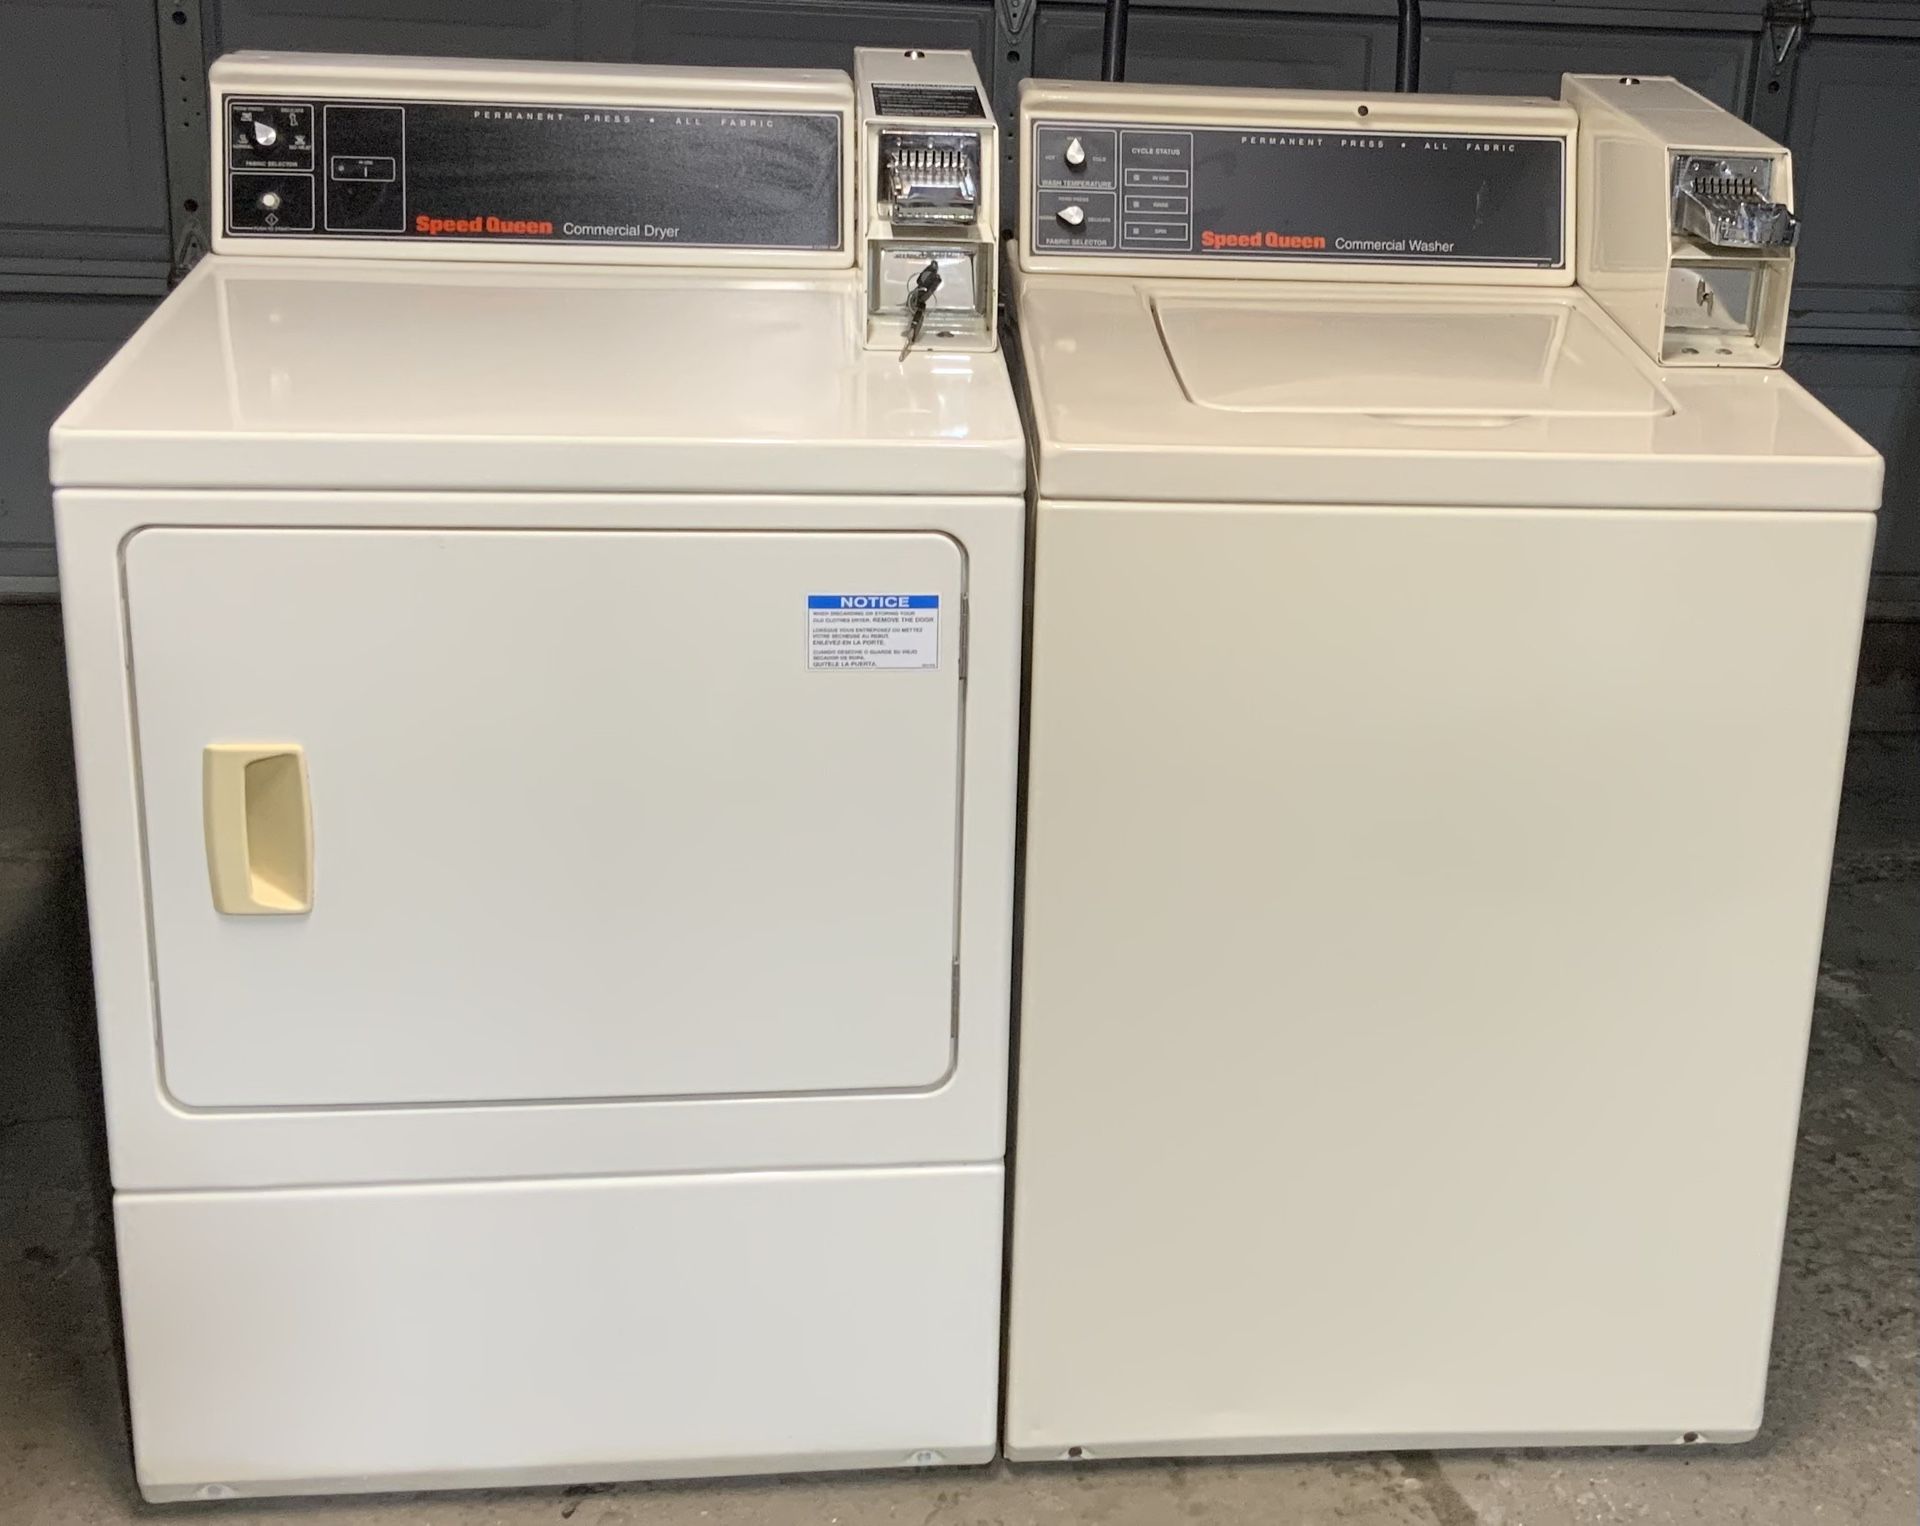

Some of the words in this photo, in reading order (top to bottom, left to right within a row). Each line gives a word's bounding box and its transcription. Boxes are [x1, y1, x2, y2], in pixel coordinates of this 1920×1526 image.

[473, 111, 565, 121] PERMANENT
[583, 114, 632, 124] PRESS
[674, 117, 701, 126] ALL
[720, 119, 776, 129] FABRIC
[1131, 147, 1154, 155] CYCLE
[1155, 148, 1181, 156] STATUS
[1241, 136, 1324, 146] PERMANENT
[1341, 139, 1385, 149] PRESS
[1424, 142, 1449, 150] ALL
[1466, 143, 1516, 152] FABRIC
[267, 160, 298, 168] SELECTOR
[1042, 179, 1063, 187] WASH
[1063, 180, 1112, 188] TEMPERATURE
[415, 215, 483, 236] Speed
[485, 215, 553, 235] Queen
[563, 221, 641, 237] Commercial
[644, 223, 680, 239] Dryer
[1201, 230, 1263, 250] Speed
[1264, 231, 1326, 249] Queen
[1335, 237, 1406, 252] Commercial
[1408, 238, 1455, 253] Washer
[840, 596, 910, 608] NOTICE
